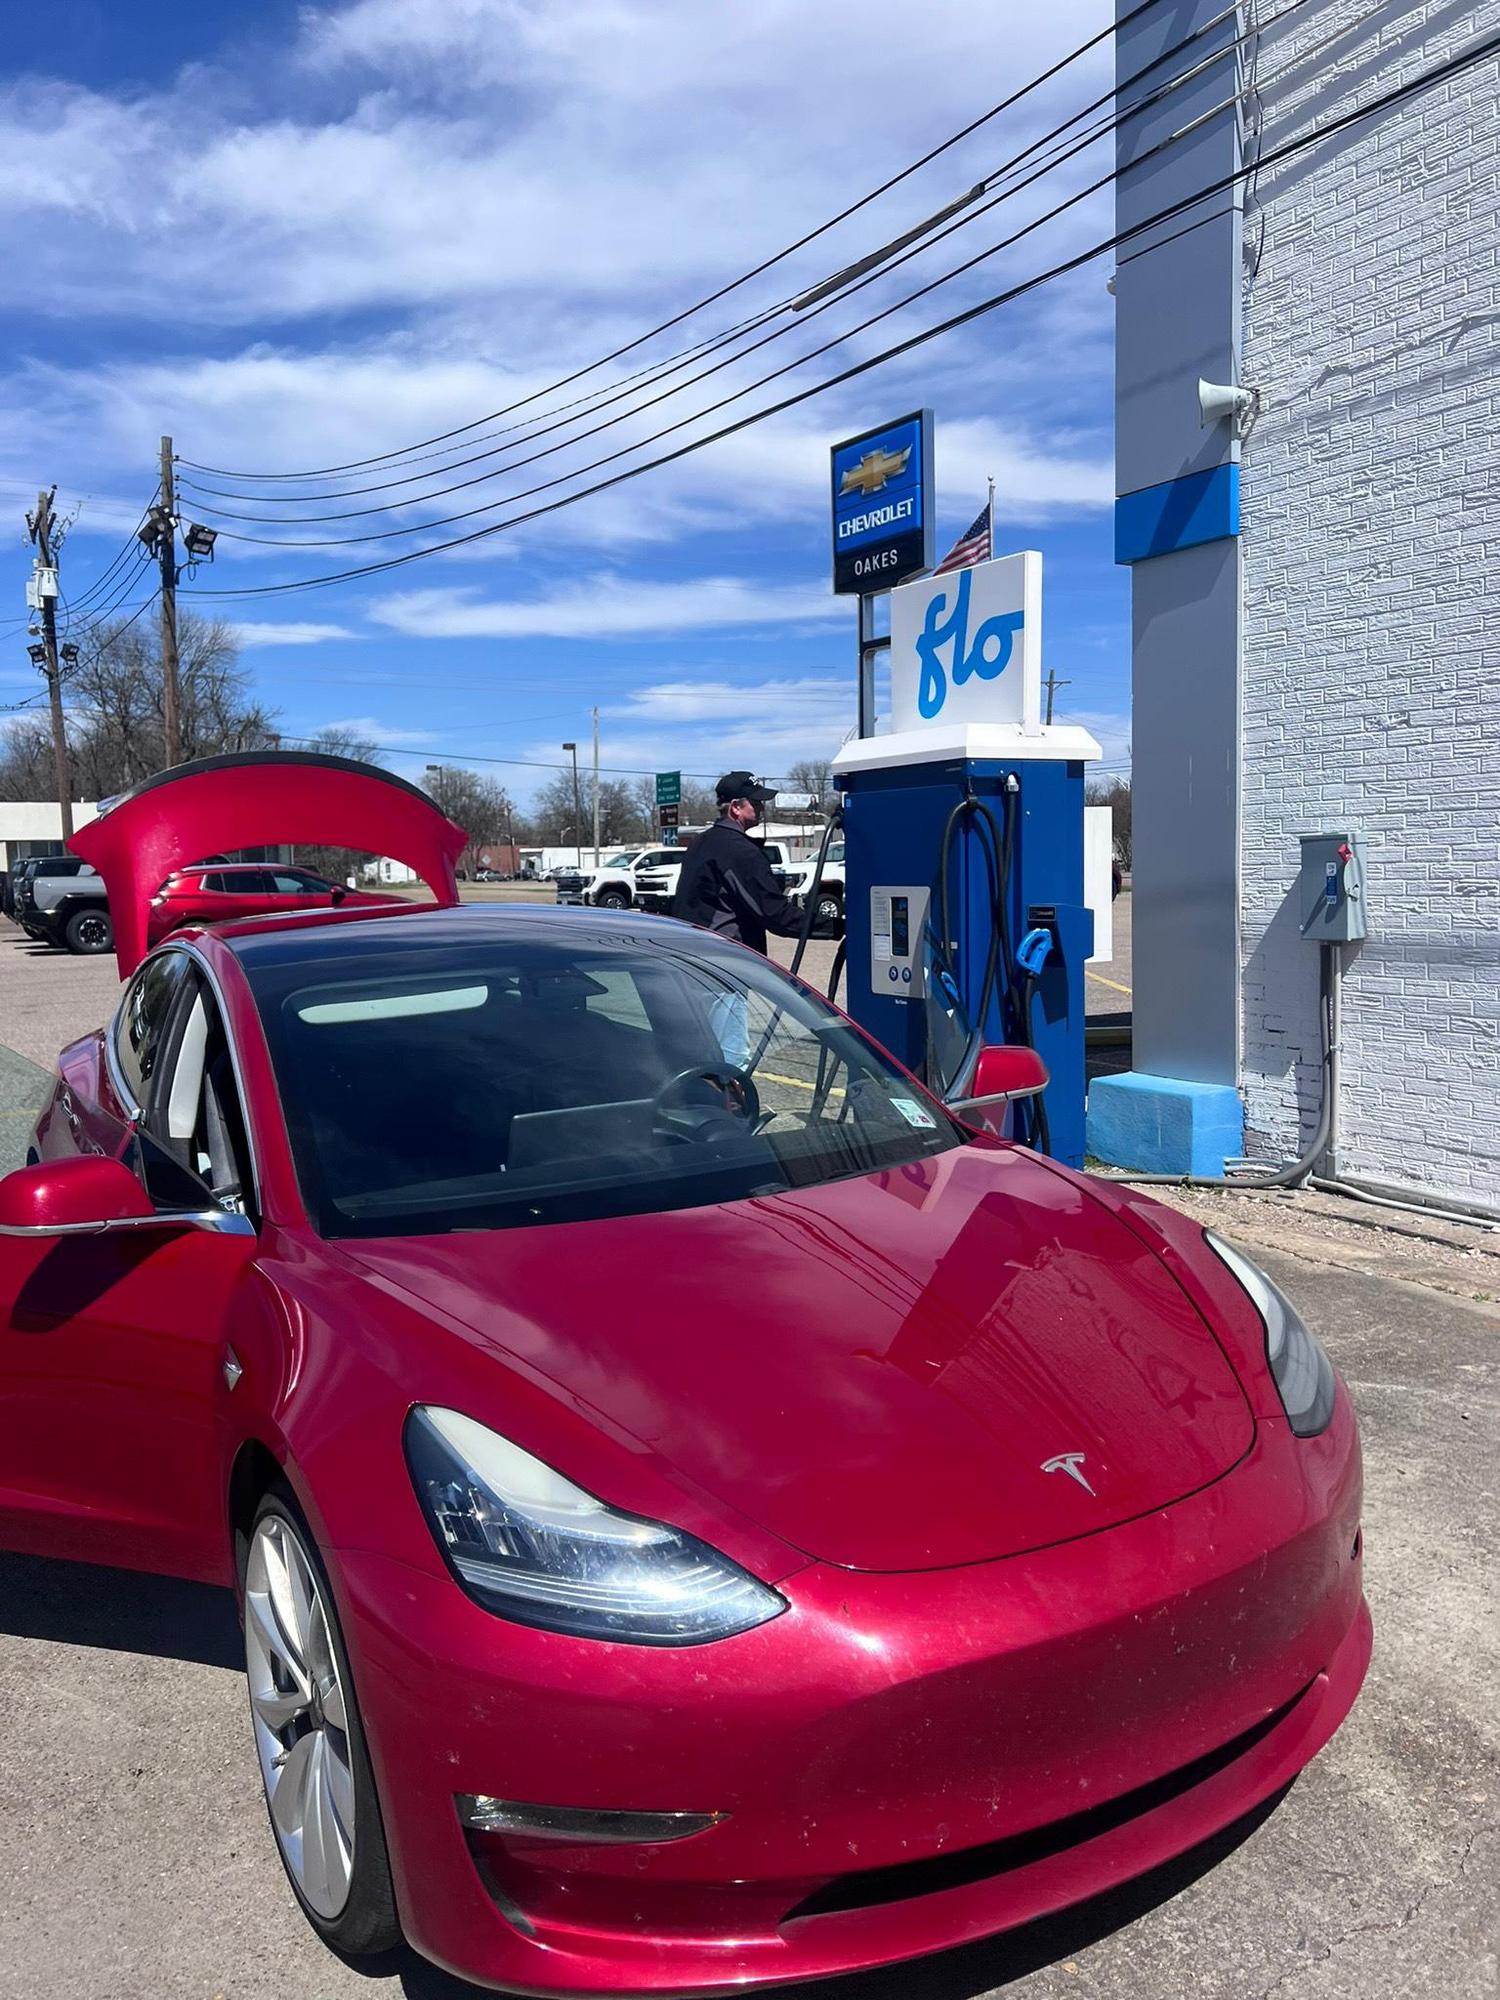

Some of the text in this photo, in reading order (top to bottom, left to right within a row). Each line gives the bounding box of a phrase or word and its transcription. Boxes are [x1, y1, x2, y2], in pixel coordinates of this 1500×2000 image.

[838, 498, 914, 538] CHEVROLET
[854, 549, 898, 576] OAKES
[916, 569, 1025, 719] flo
